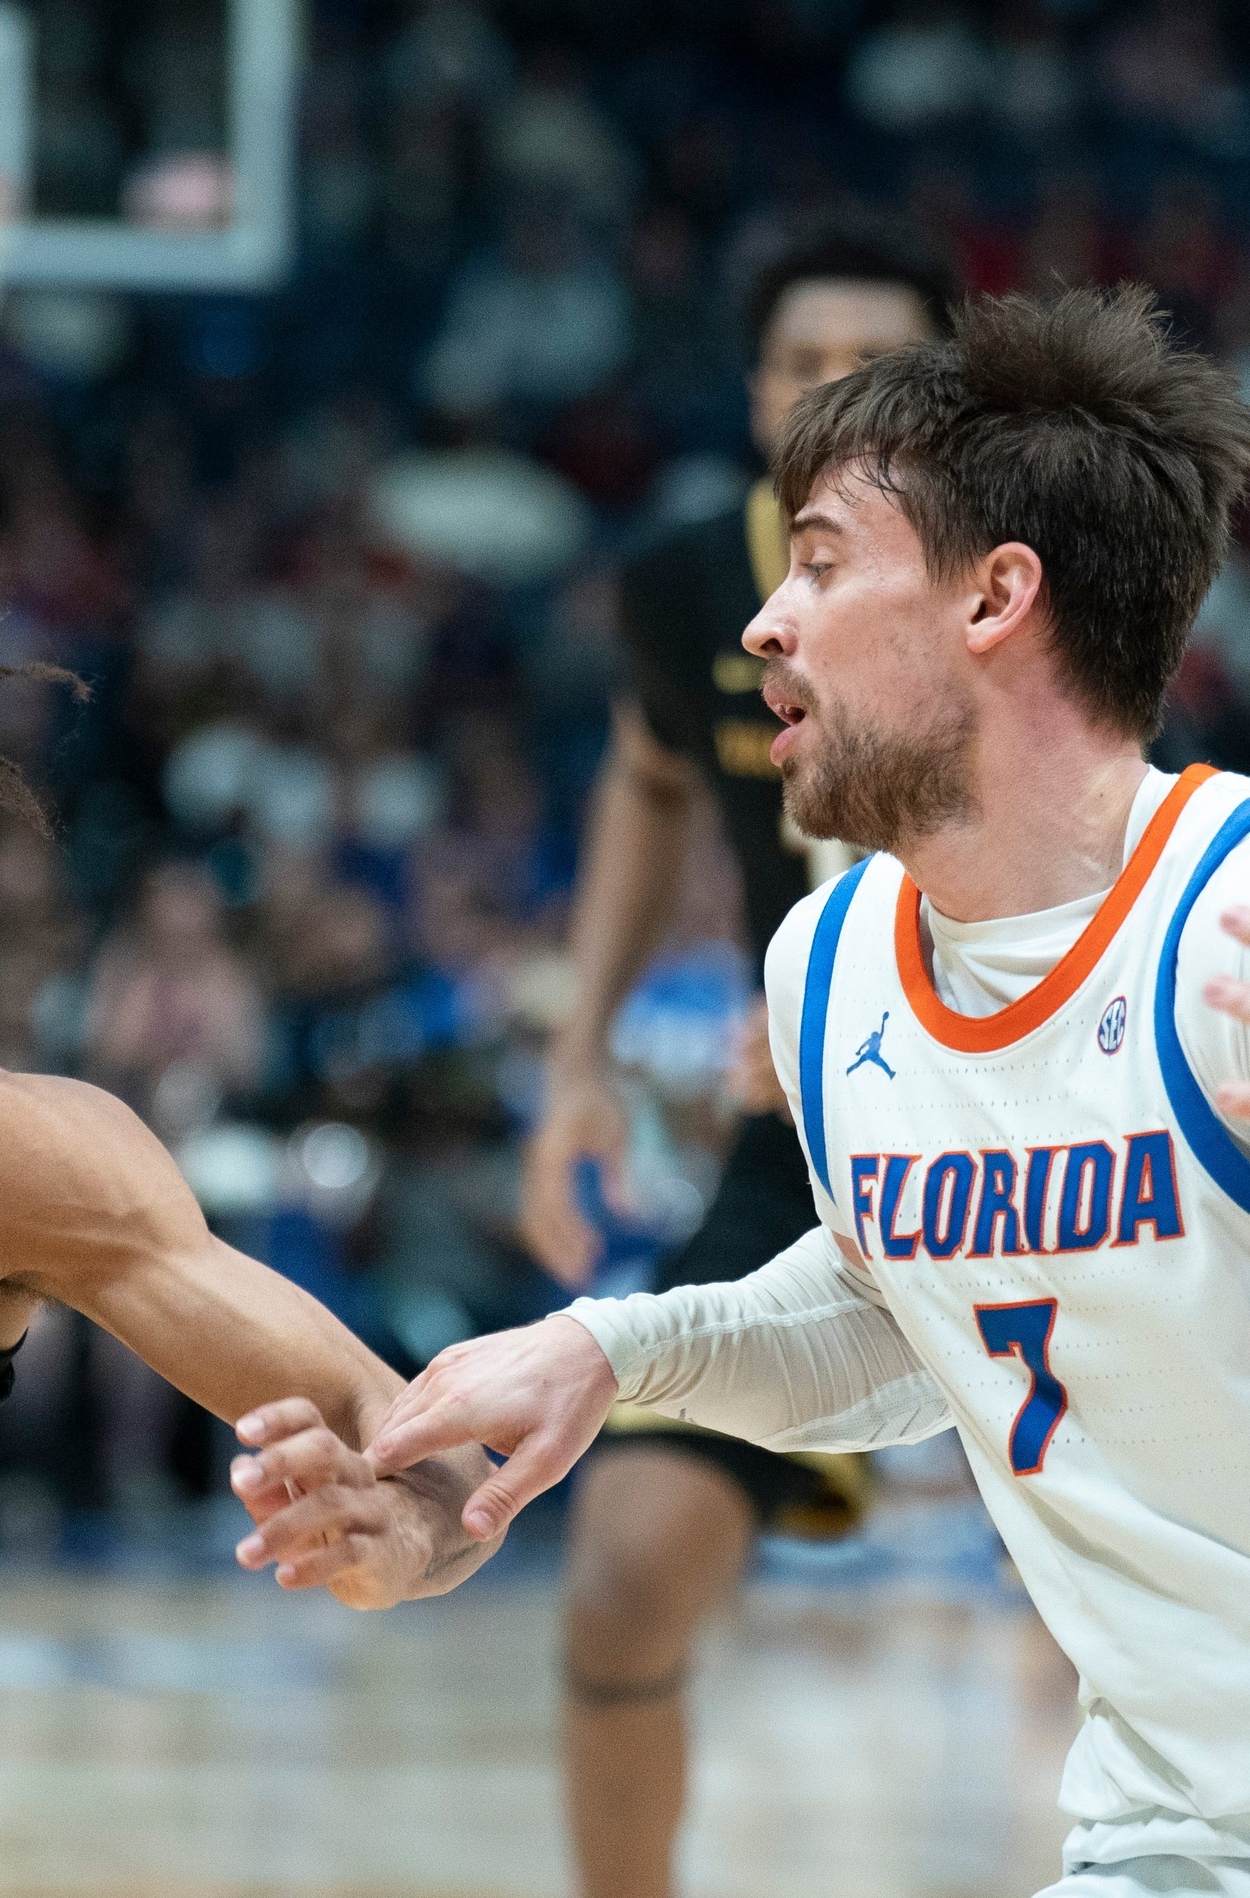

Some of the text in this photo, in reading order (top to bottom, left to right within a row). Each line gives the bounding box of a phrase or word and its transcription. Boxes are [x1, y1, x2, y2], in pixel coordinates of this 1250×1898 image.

[1098, 998, 1126, 1052] SEC
[850, 1130, 1186, 1260] FLORIDA
[974, 1298, 1068, 1476] 7
